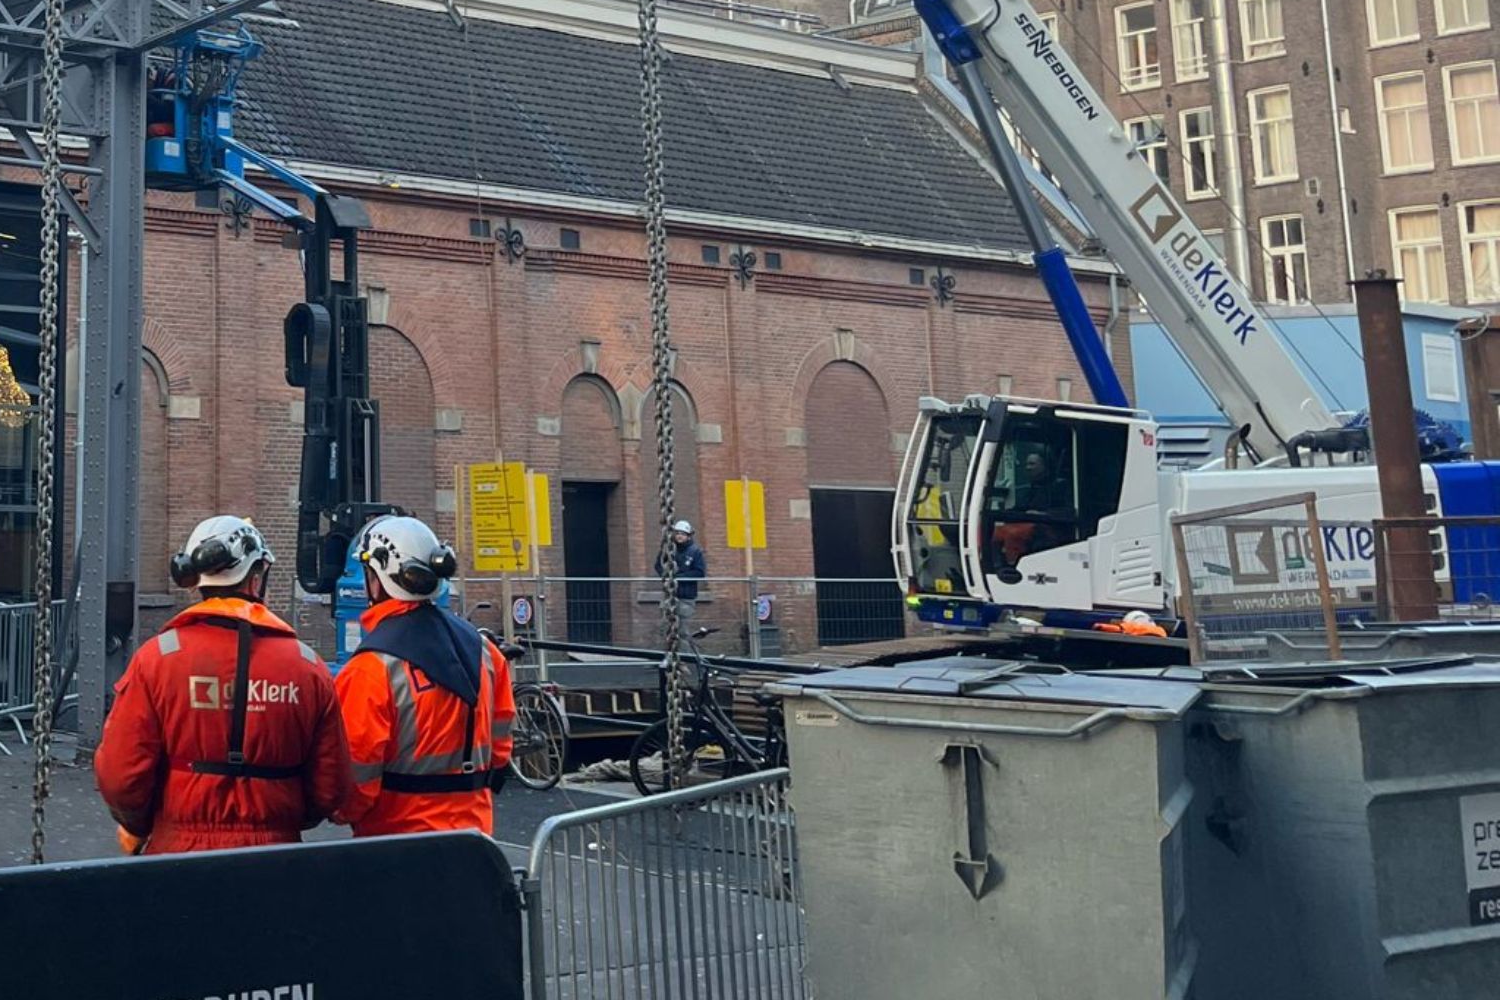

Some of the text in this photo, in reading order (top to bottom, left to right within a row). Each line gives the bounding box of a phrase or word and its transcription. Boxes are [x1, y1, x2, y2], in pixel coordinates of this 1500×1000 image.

[1014, 13, 1099, 120] SENNEBOGEN
[1161, 249, 1206, 310] WERKENDAM
[224, 679, 299, 704] dKlerk
